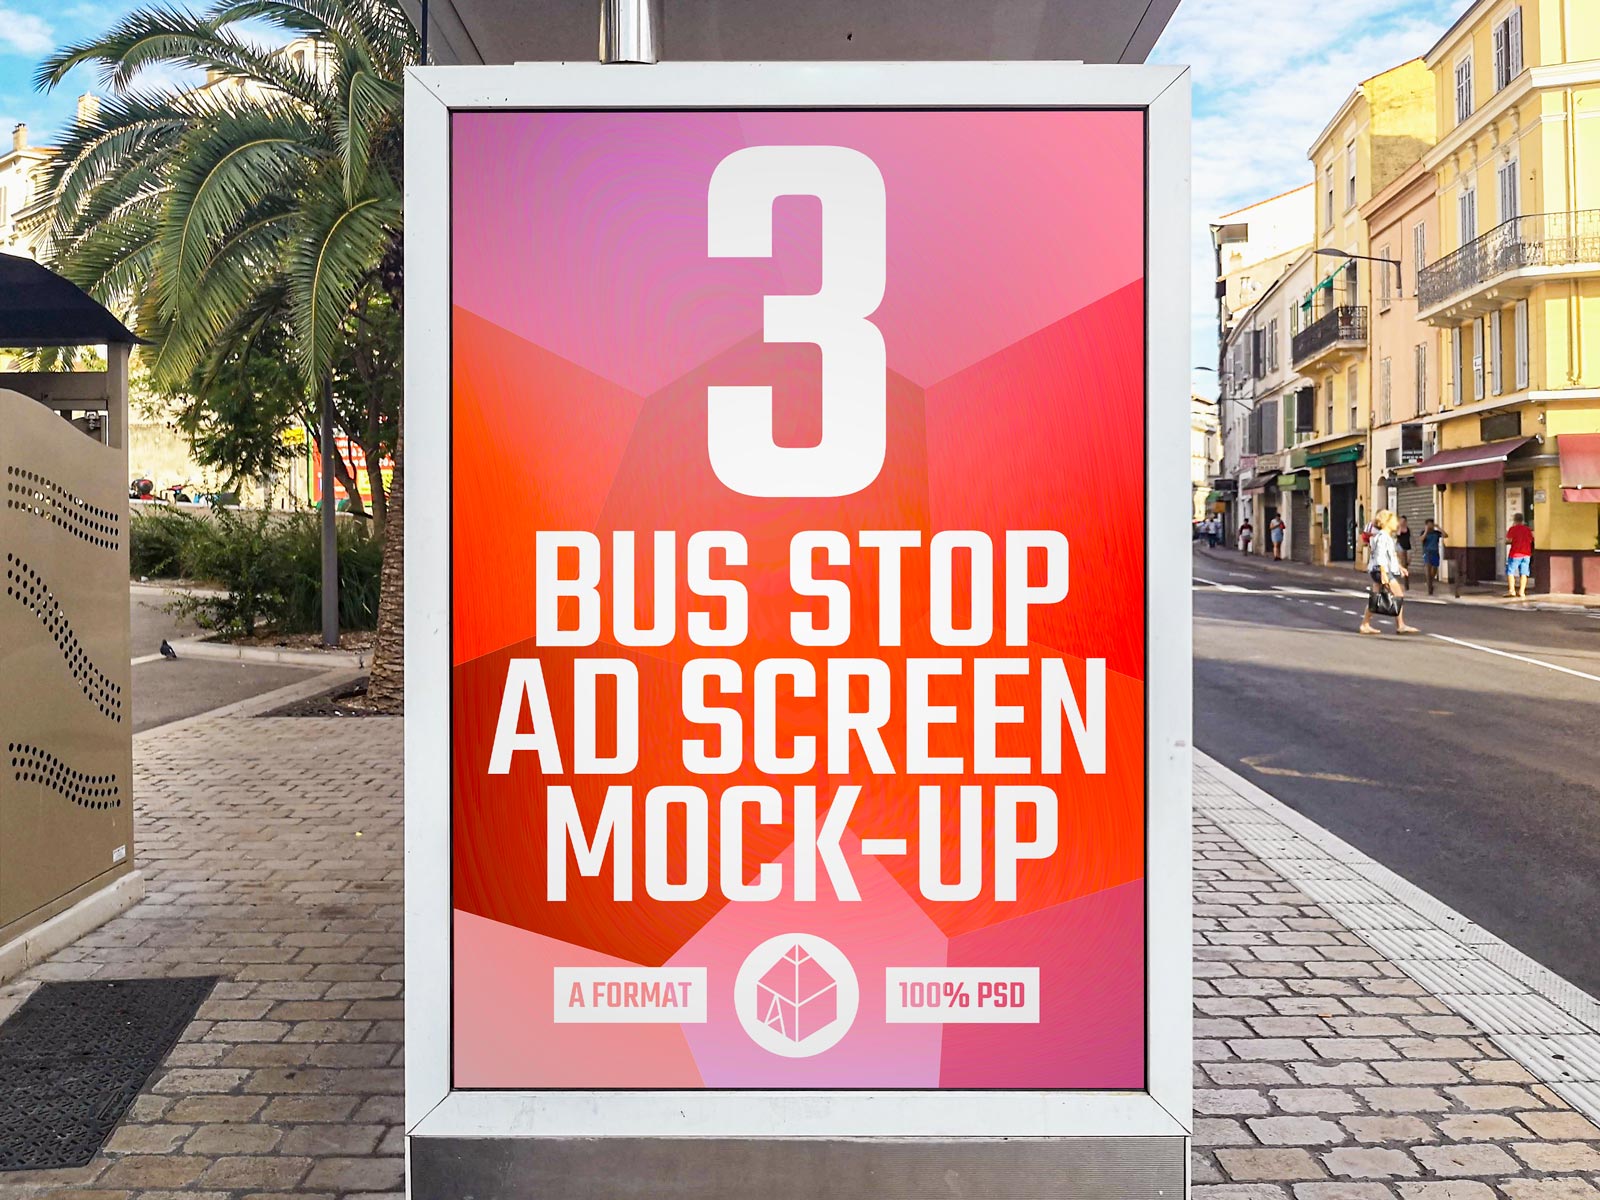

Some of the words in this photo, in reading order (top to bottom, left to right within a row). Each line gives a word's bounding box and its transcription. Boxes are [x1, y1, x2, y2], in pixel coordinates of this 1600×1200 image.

[708, 146, 886, 497] 3
[537, 531, 747, 646] BUS
[790, 531, 1068, 646] STOP
[489, 659, 638, 773] AD
[682, 658, 1105, 774] SCREEN
[548, 786, 1057, 901] MOCK-UP
[569, 982, 585, 1007] A
[593, 982, 692, 1007] FORMAT
[899, 982, 969, 1007] 100%
[978, 982, 1025, 1008] PSD
